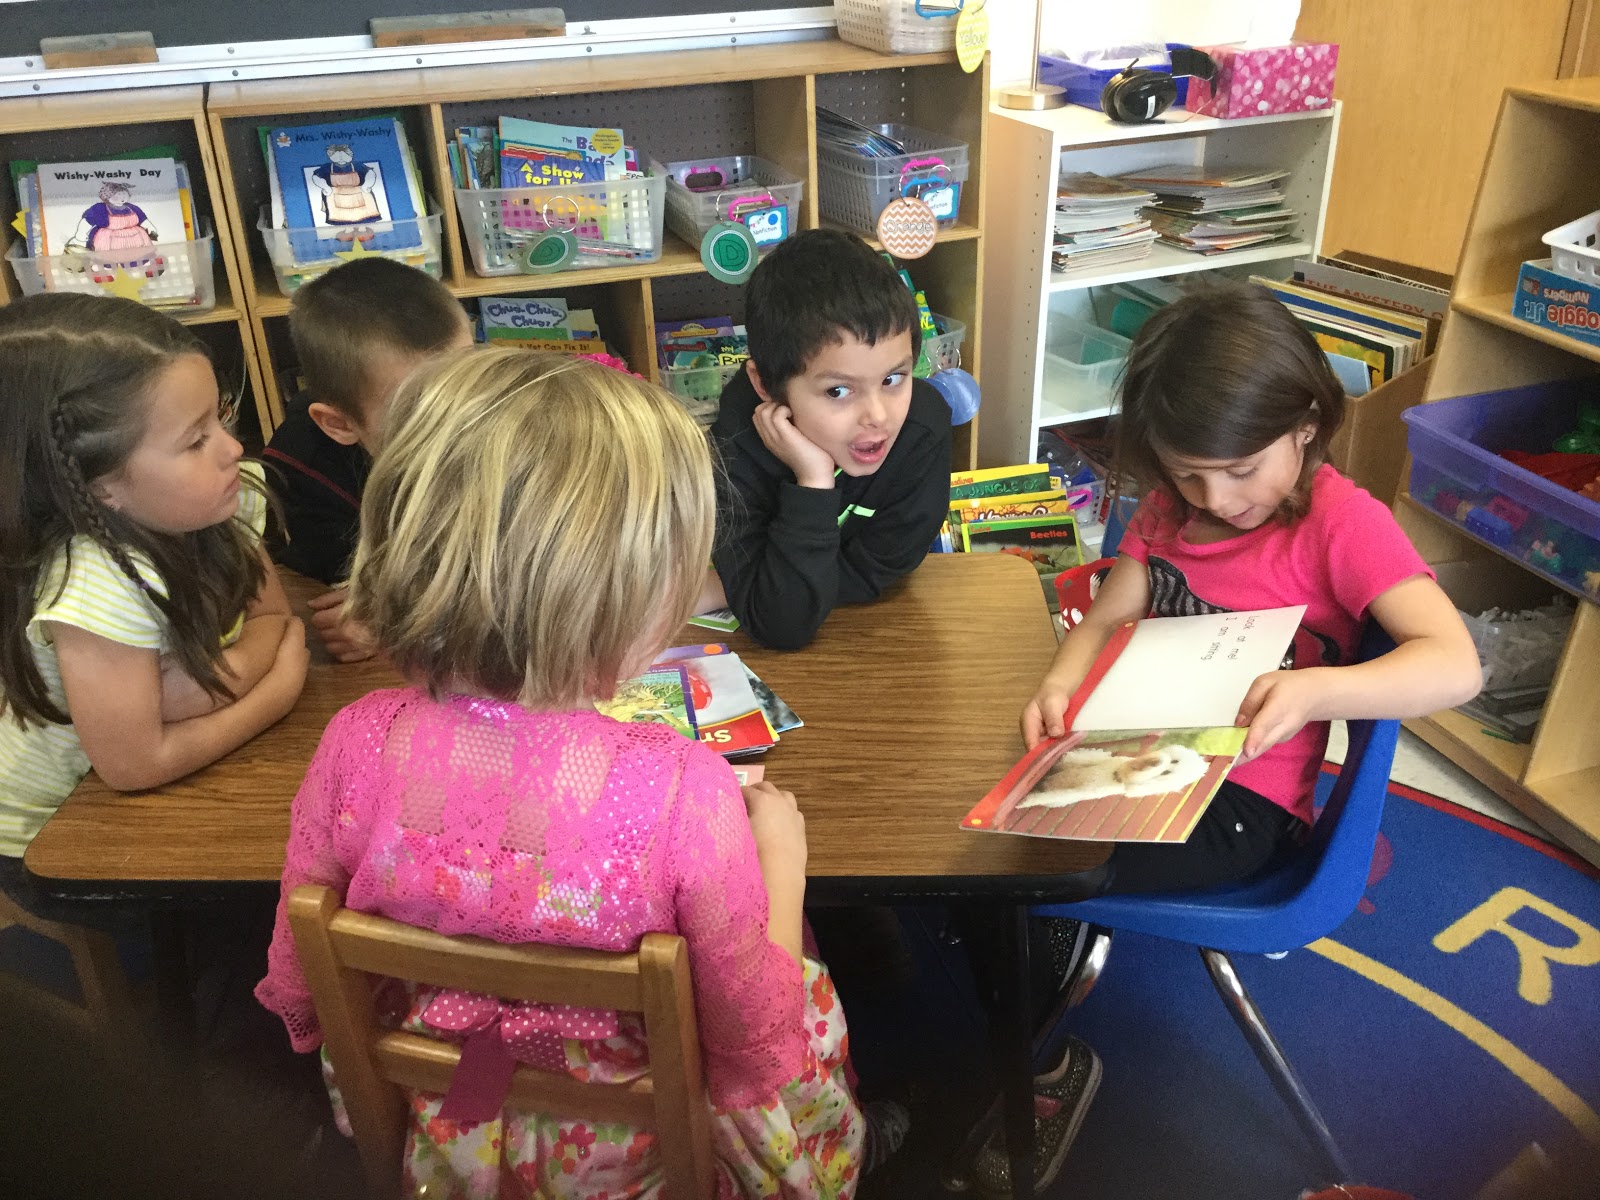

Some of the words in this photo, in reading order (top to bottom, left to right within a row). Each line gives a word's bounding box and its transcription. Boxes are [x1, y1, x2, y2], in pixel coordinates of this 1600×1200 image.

[321, 127, 392, 141] Wishy-Washy
[561, 136, 573, 144] The
[54, 168, 132, 182] Wishy-Washy
[139, 167, 162, 182] Day
[520, 162, 533, 173] A
[541, 164, 585, 181] Show
[525, 172, 552, 186] for
[886, 219, 933, 235] Orange
[1547, 304, 1600, 331] oggle
[968, 481, 1019, 498] JUNGLE
[1030, 530, 1068, 540] Beetles
[1217, 626, 1229, 637] am
[1432, 886, 1600, 1006] R
